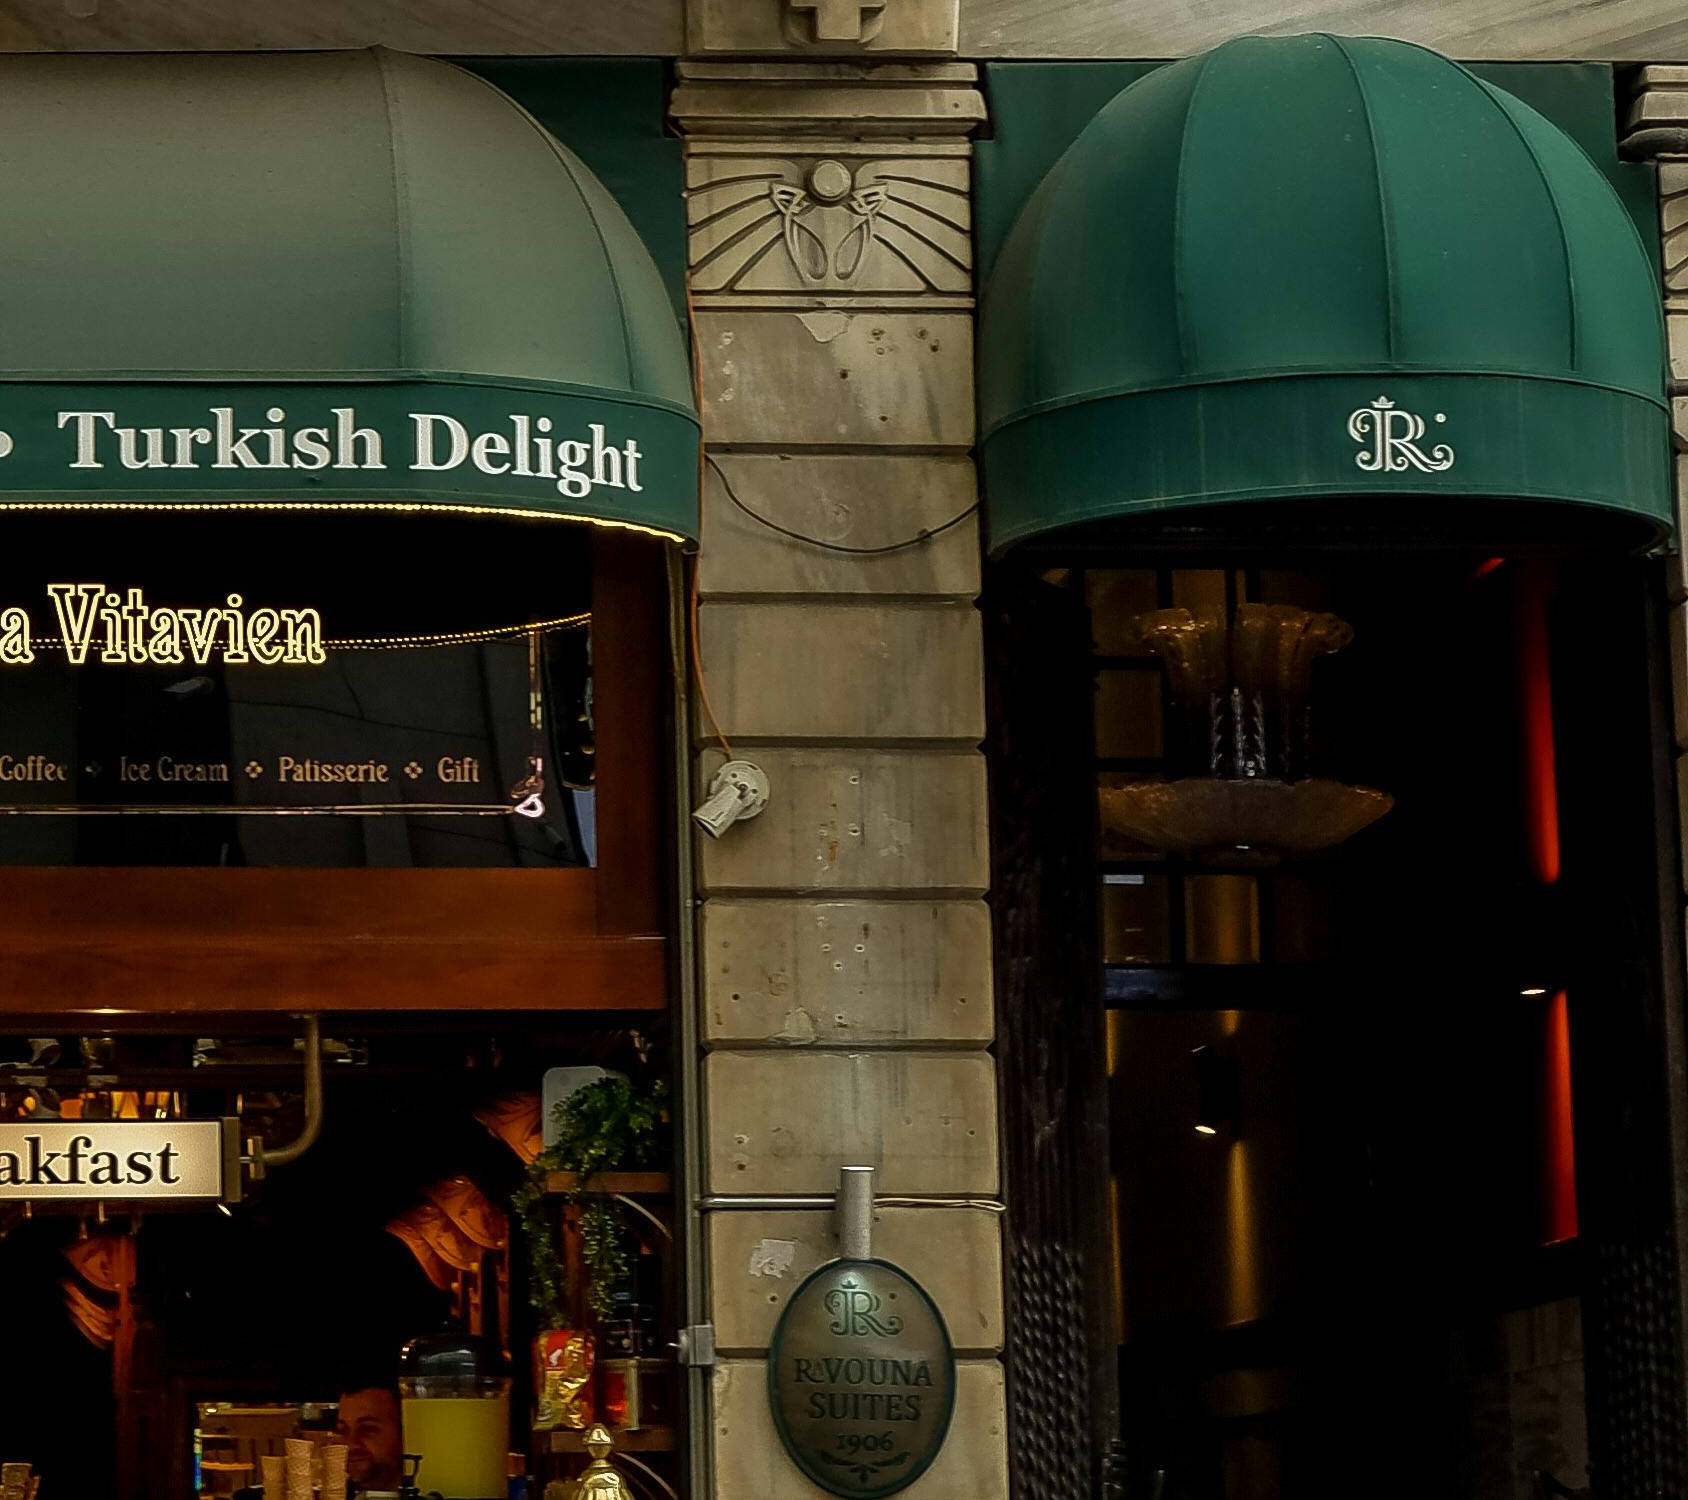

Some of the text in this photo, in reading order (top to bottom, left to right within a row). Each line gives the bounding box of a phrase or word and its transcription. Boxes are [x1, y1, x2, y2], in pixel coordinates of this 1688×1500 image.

[56, 406, 386, 470] Turkish
[409, 412, 645, 498] Delight
[47, 582, 326, 664] Vitavien
[119, 755, 152, 783] Ice
[157, 755, 229, 783] Cream
[277, 754, 389, 783] Patisserie
[437, 753, 480, 783] Gift
[808, 1392, 922, 1421] SUITES
[837, 1431, 894, 1455] 1906
